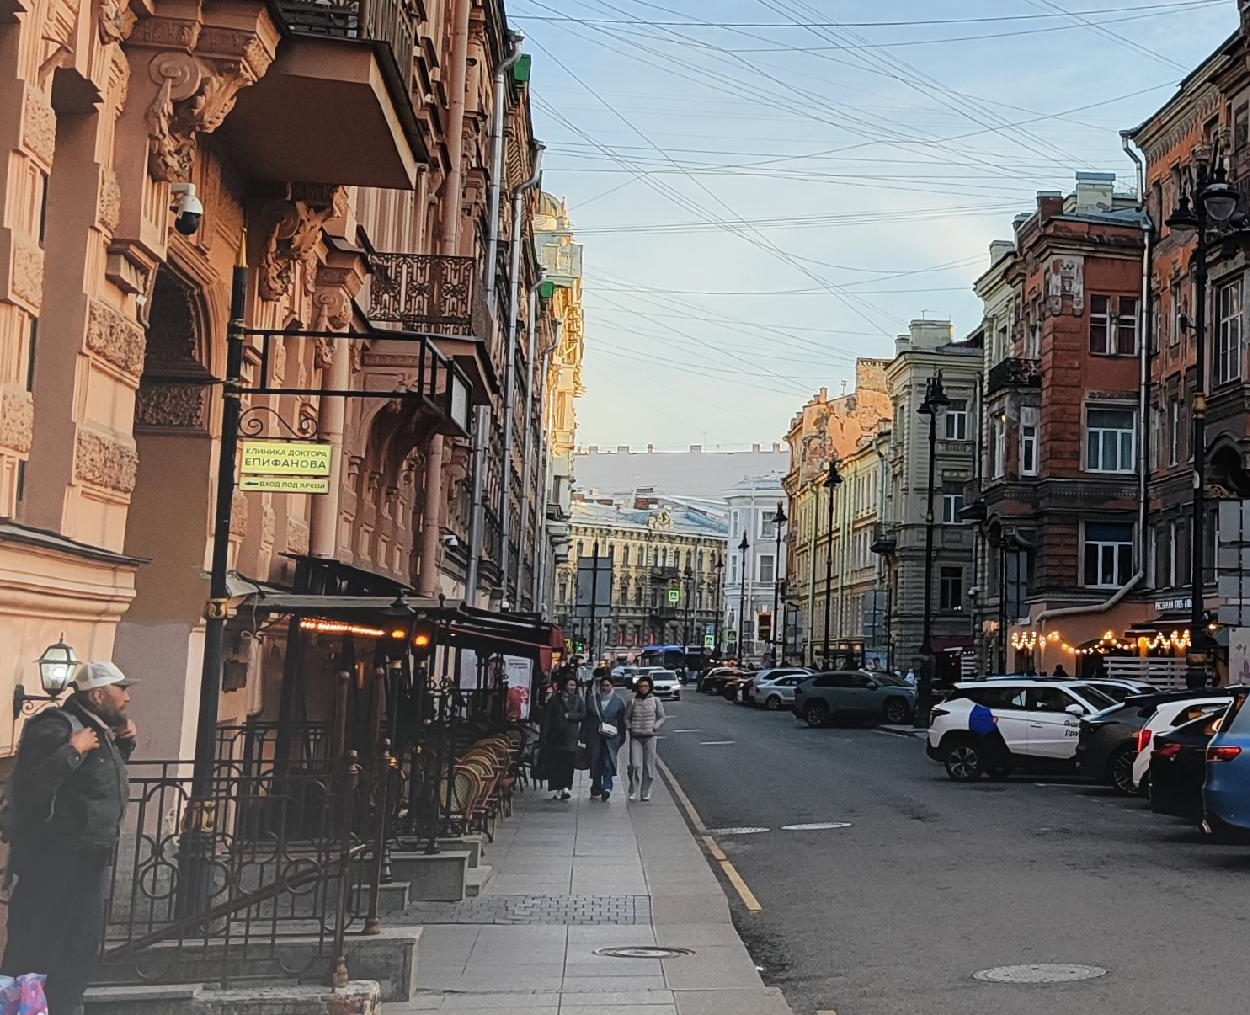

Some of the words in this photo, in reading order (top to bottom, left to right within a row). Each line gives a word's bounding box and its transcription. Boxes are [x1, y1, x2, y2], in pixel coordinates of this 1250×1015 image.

[246, 447, 286, 456] КЛИНИКА
[288, 449, 328, 458] ДОКТОРА
[244, 457, 327, 470] ЕПИФАНОВА
